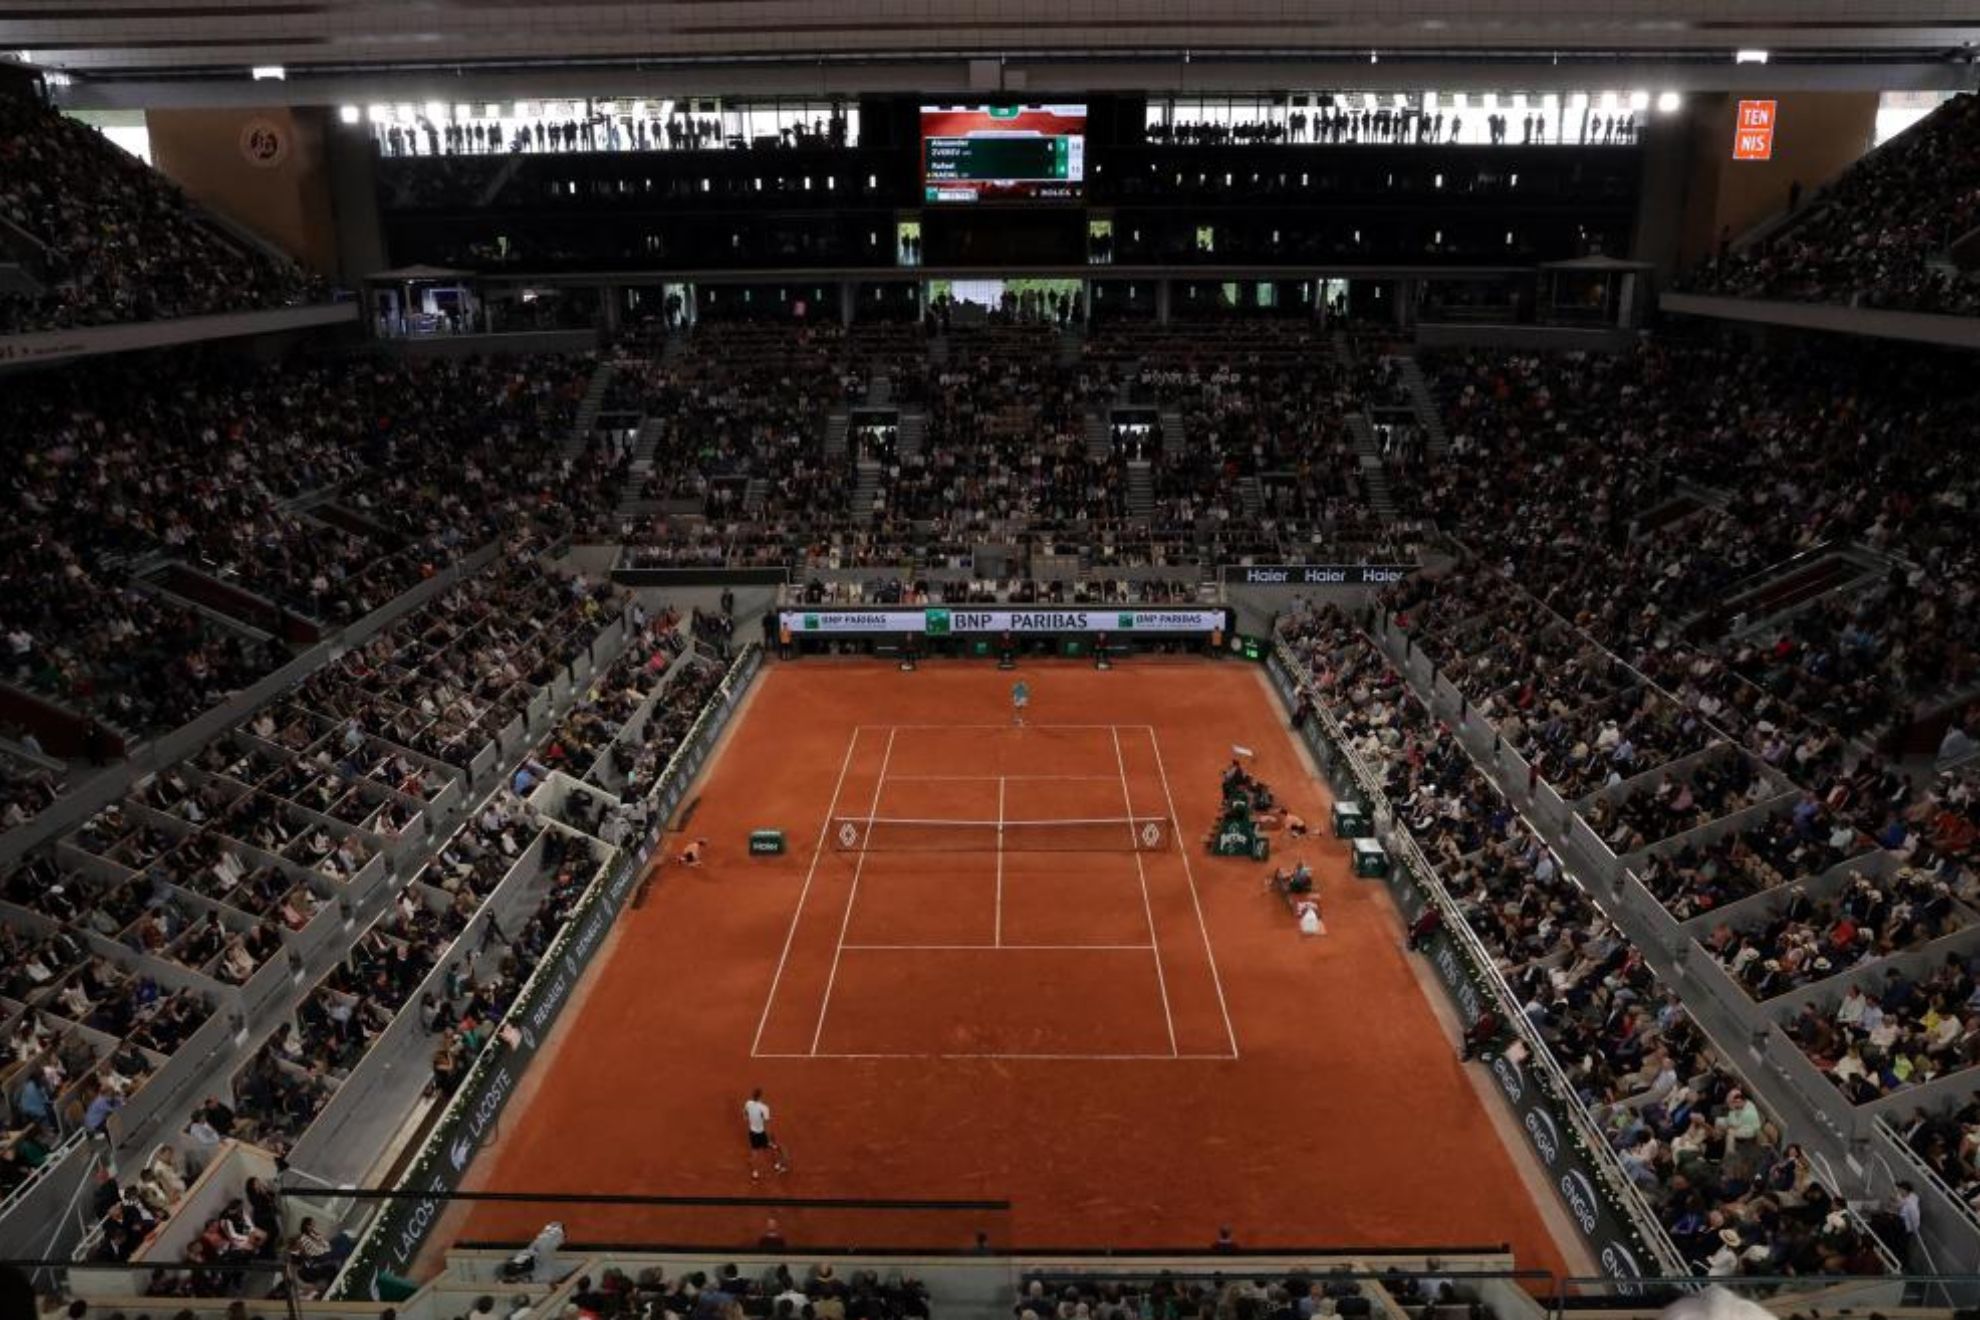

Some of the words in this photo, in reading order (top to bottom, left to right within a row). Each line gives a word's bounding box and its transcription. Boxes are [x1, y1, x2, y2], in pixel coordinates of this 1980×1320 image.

[1744, 109, 1769, 126] TEN
[1742, 135, 1766, 152] NIS
[1246, 568, 1288, 582] Haier
[1304, 568, 1346, 582] Haier
[955, 614, 993, 628] BNP
[1011, 614, 1088, 628] PARIBAS
[469, 1067, 512, 1137] LACOSTE
[392, 1174, 448, 1265] LACOSTE
